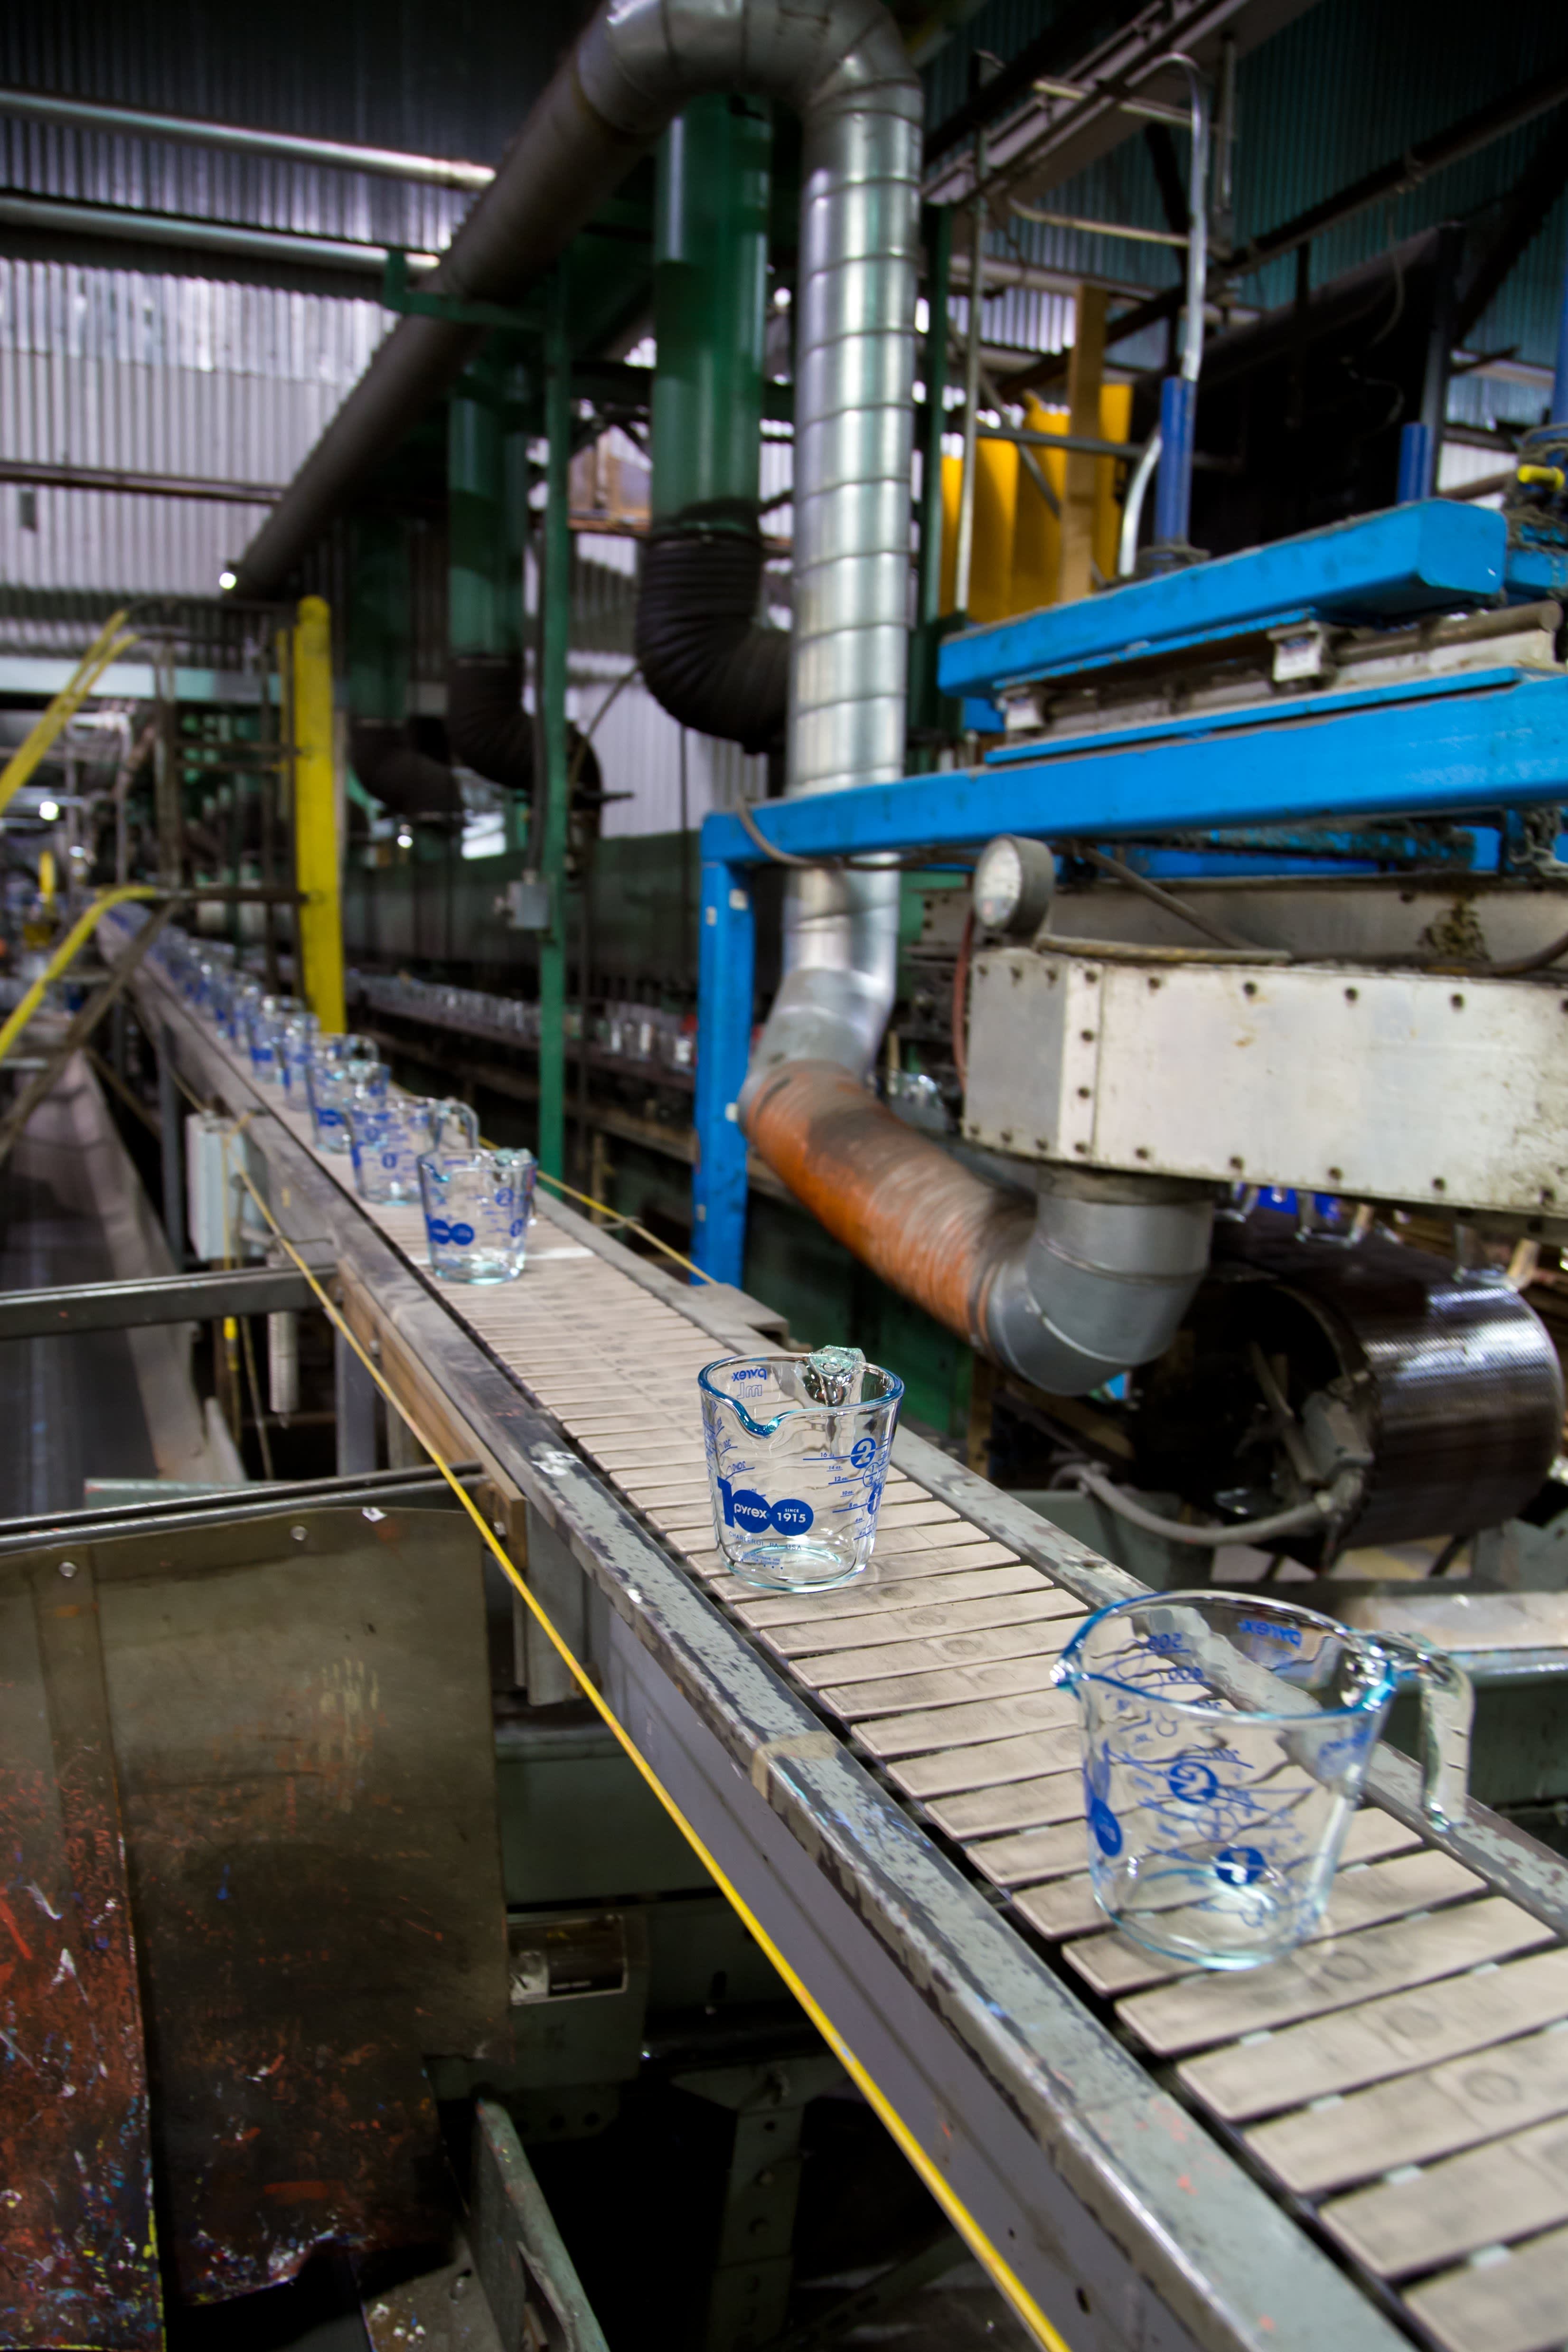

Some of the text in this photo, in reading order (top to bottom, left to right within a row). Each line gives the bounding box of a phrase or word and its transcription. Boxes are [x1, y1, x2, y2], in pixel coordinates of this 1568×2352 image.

[734, 1503, 767, 1519] pyrex
[777, 1513, 807, 1523] 1915
[729, 1531, 764, 1546] CHARLEROI
